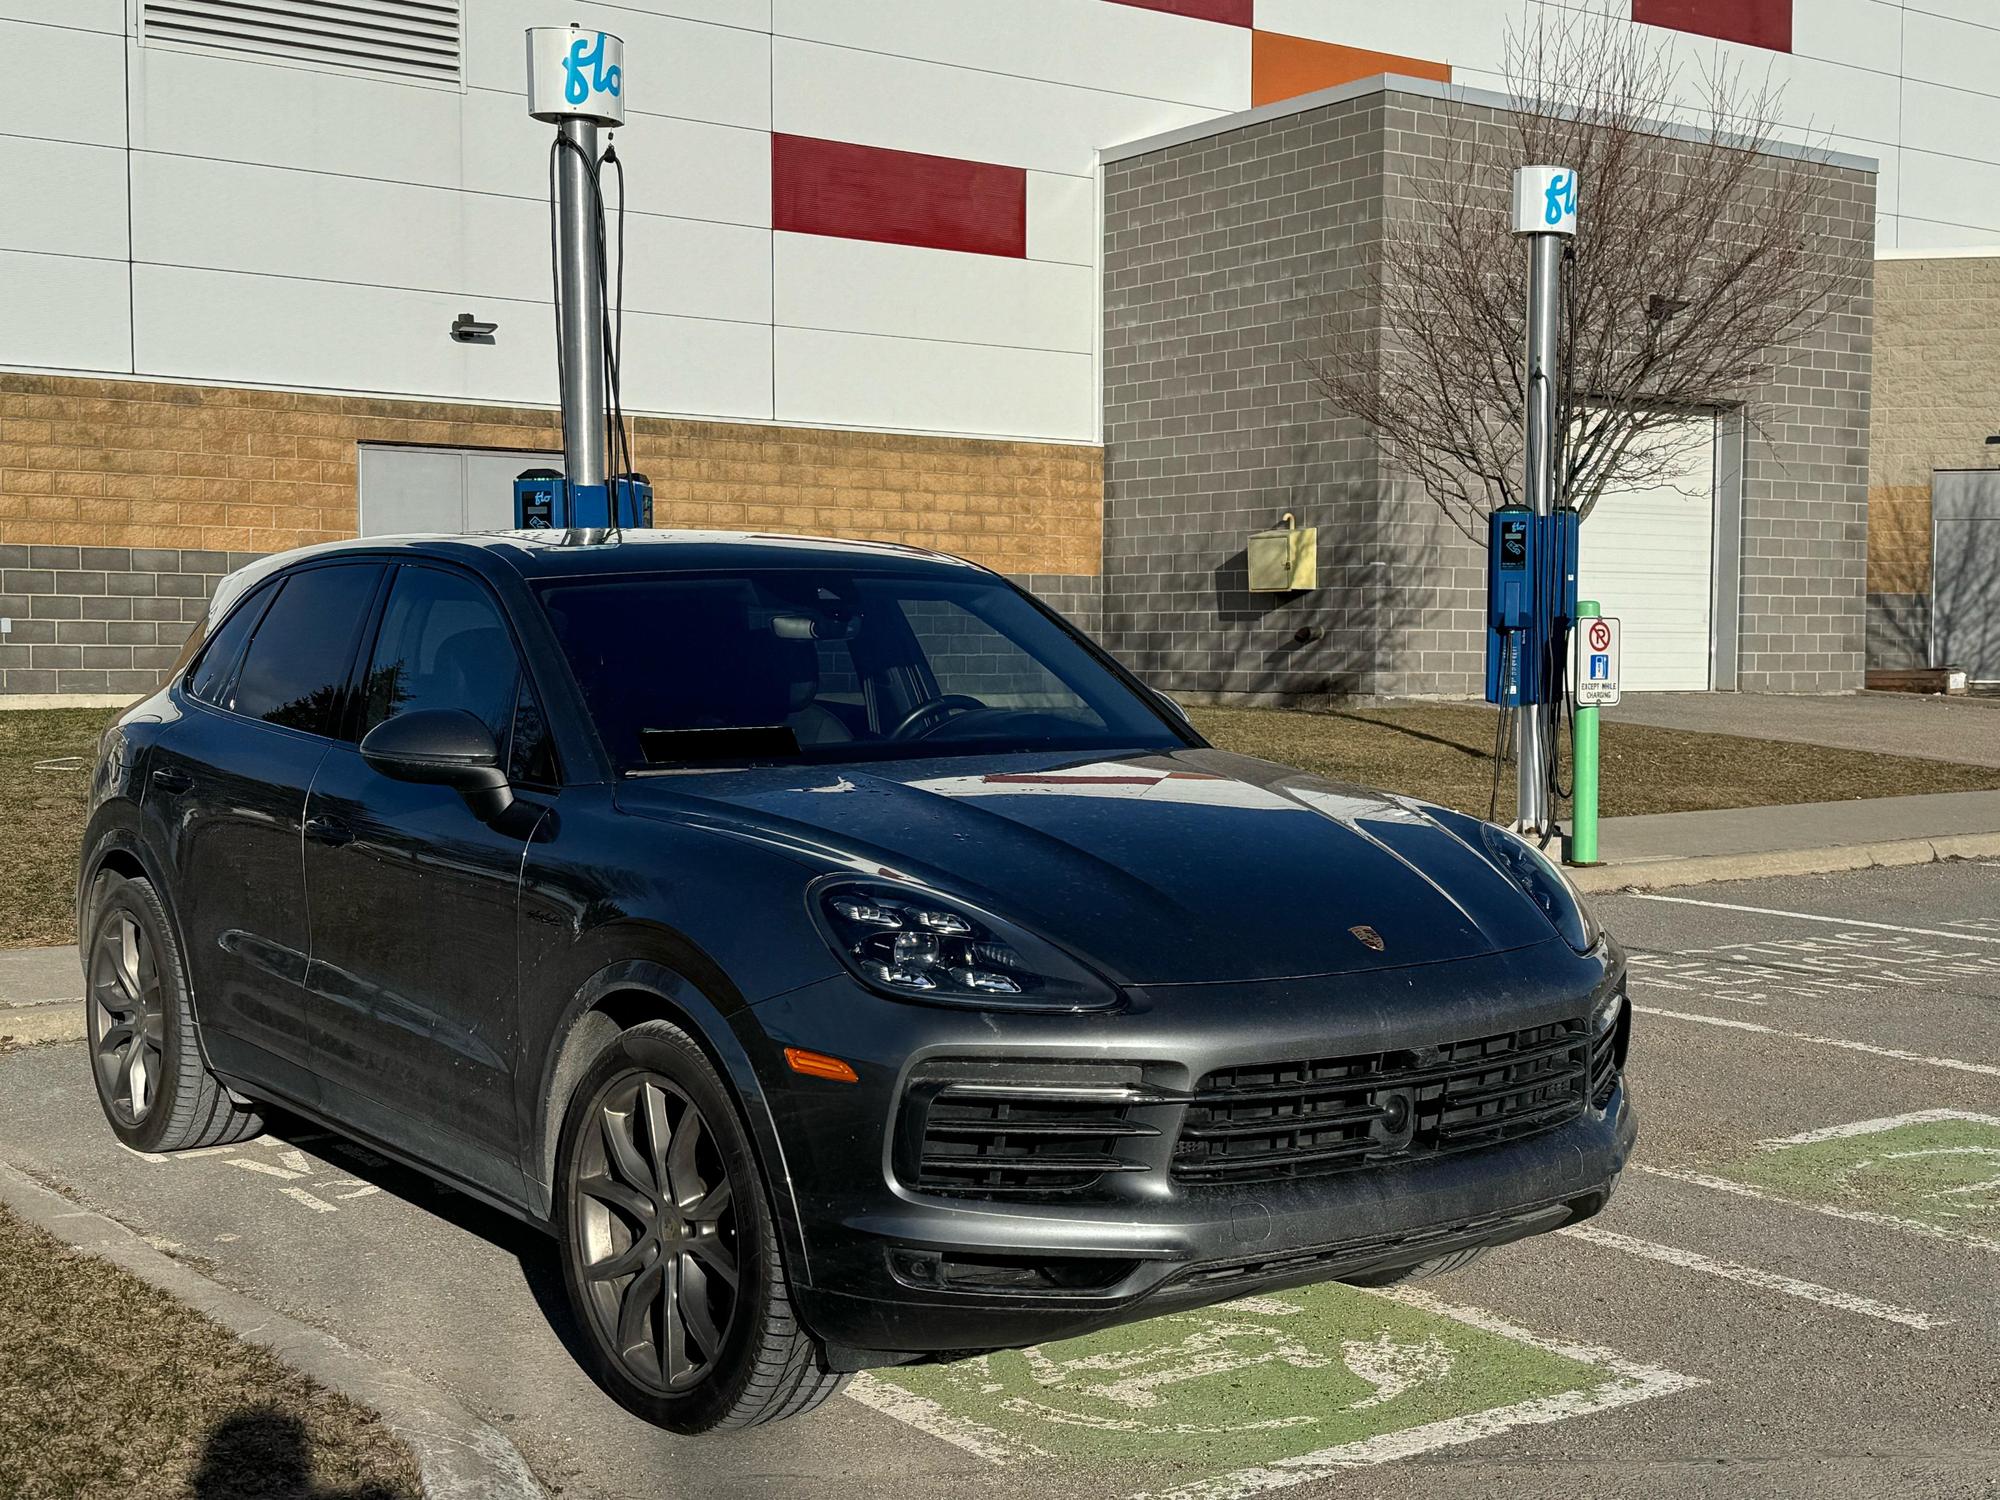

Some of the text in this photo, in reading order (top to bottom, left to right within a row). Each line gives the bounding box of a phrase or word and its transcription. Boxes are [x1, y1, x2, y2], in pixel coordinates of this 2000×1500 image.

[562, 31, 621, 105] flo
[535, 491, 552, 506] flo
[1511, 521, 1526, 533] flo
[1581, 682, 1617, 690] EXCEPT WHILE
[1586, 691, 1612, 699] CHARGING
[1626, 932, 1911, 973] ECTRIC
